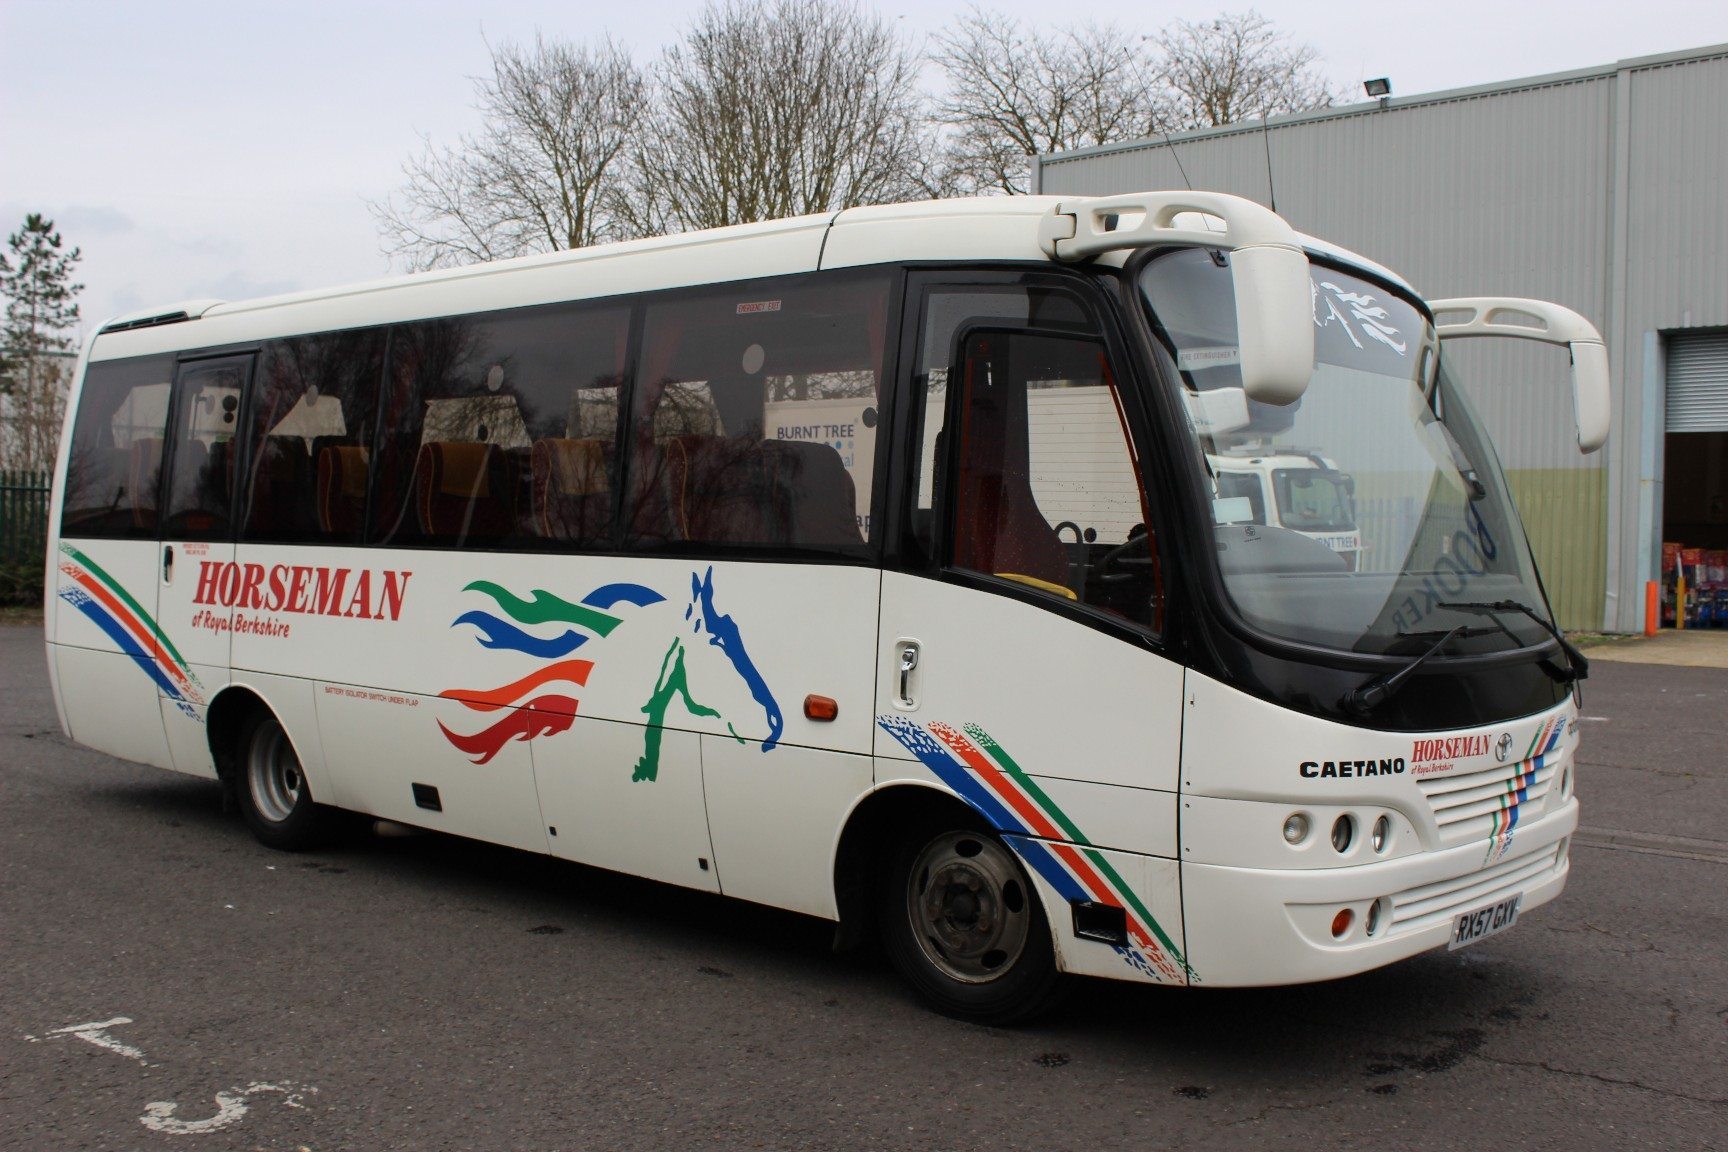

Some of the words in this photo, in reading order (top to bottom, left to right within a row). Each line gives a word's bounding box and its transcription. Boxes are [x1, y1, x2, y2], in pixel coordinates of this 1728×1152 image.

[738, 302, 765, 313] EMERGENCY
[768, 301, 780, 311] EXIT
[777, 426, 821, 440] BURNT
[823, 424, 855, 438] TREE
[1336, 536, 1353, 549] TREE
[192, 561, 413, 622] HORSEMAN
[191, 610, 204, 629] of
[203, 611, 234, 636] Royal
[234, 613, 290, 639] Berkshire
[324, 686, 344, 696] BATTERY
[368, 693, 387, 702] SWITCH
[387, 696, 405, 705] UNDER
[405, 698, 419, 707] FLAP
[1411, 734, 1492, 763] HORSEMAN
[1299, 757, 1405, 778] CAETANO
[1411, 766, 1418, 775] of
[1417, 765, 1432, 775] Royal
[1432, 762, 1454, 773] Berkshire
[1456, 906, 1494, 943] RX57
[1492, 896, 1518, 930] GXV
